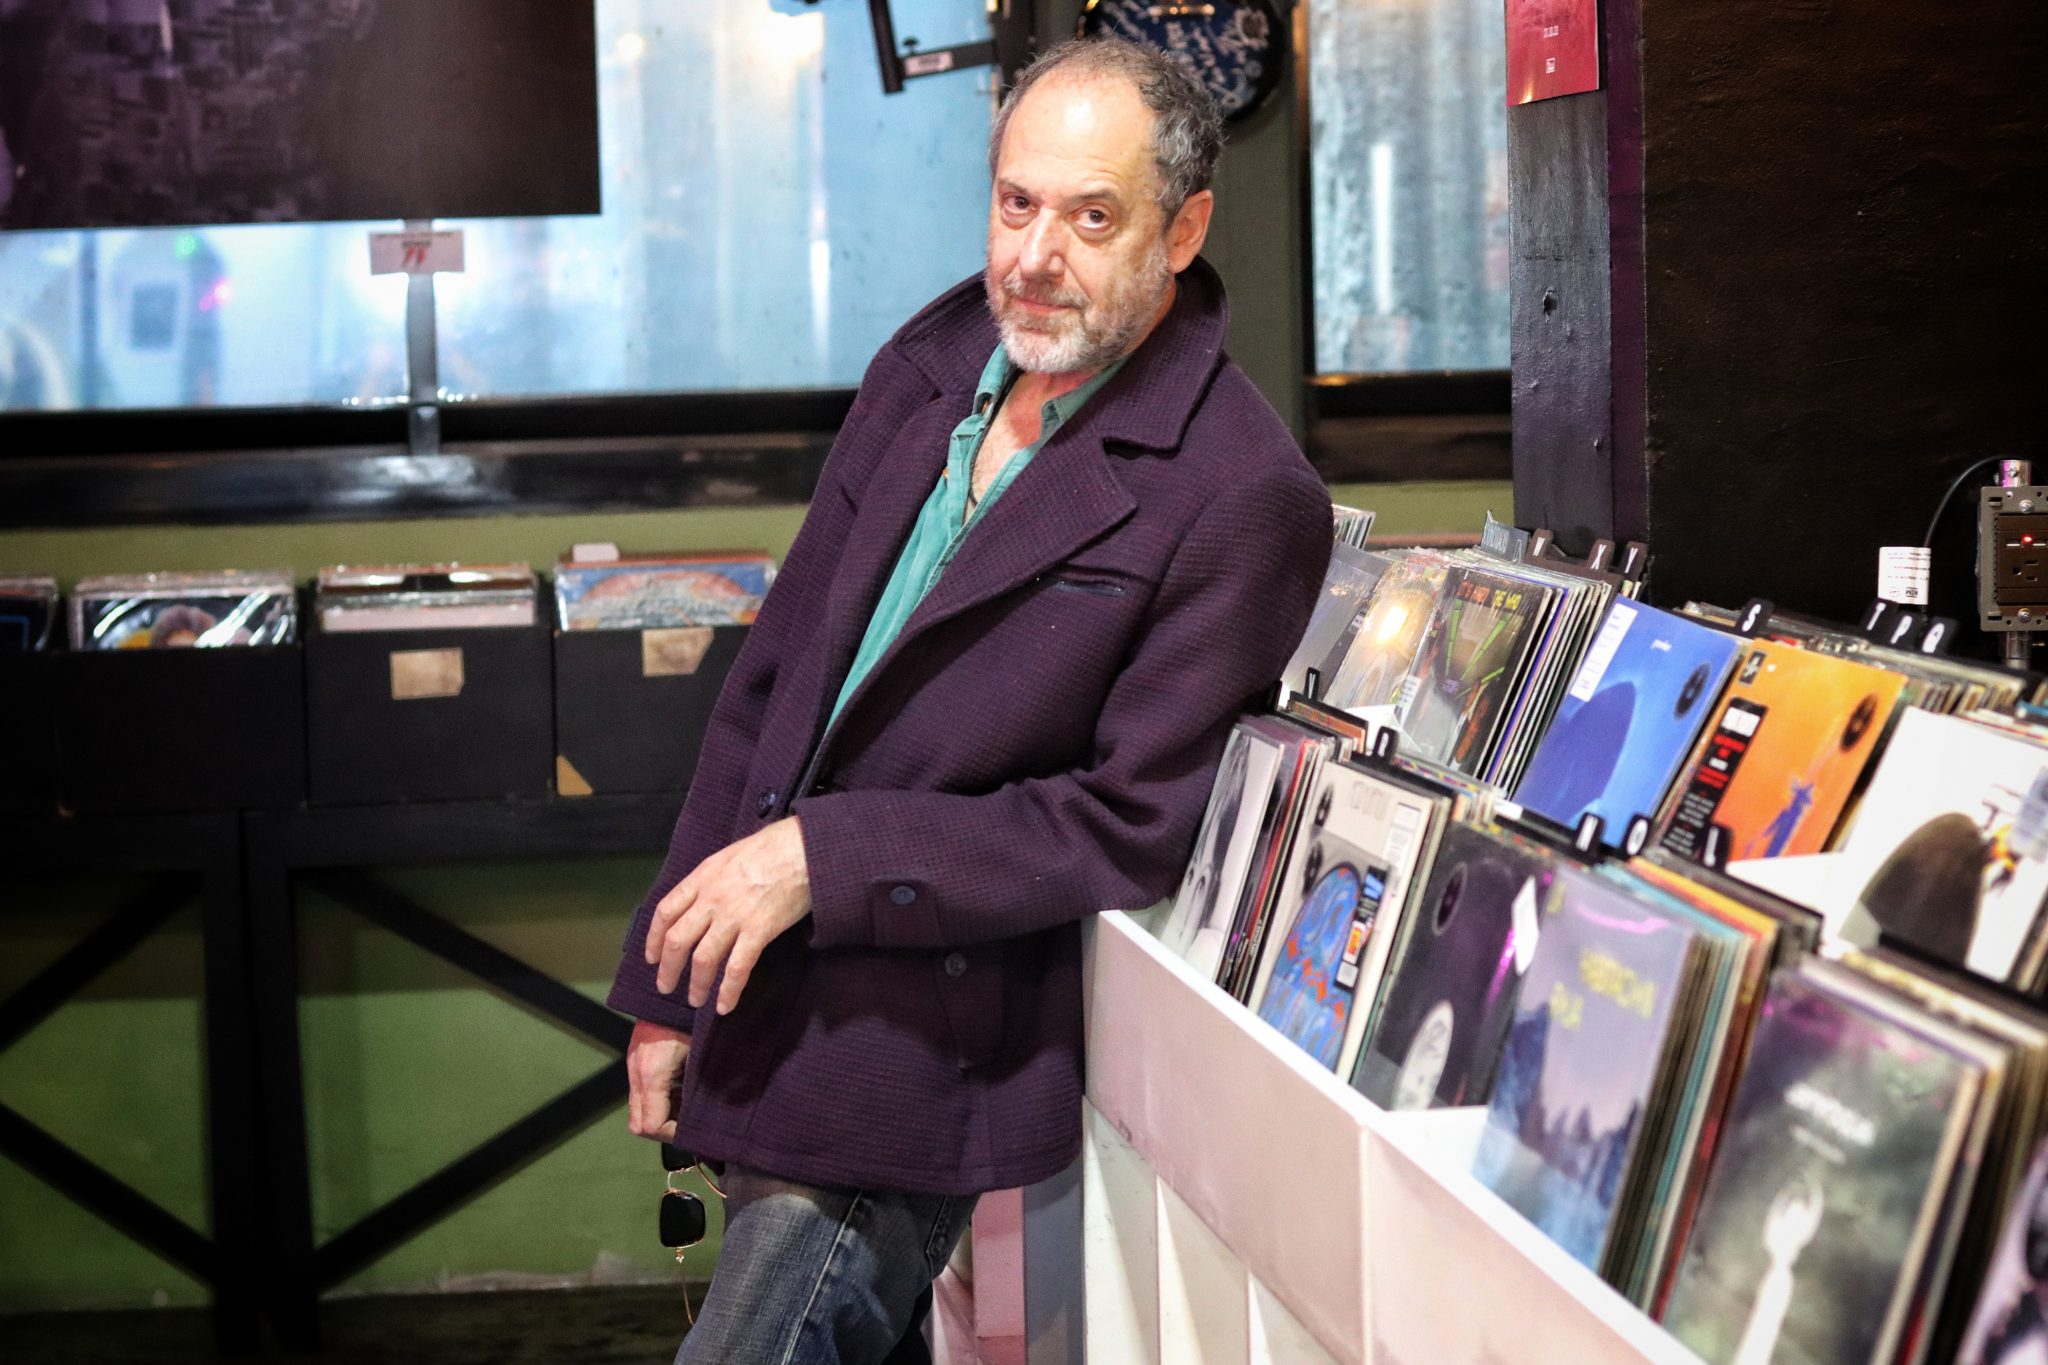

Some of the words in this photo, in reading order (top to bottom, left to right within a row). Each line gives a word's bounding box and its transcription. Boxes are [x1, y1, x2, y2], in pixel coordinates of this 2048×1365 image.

[1591, 544, 1607, 570] X
[1624, 547, 1639, 573] Y
[1741, 603, 1762, 632] S
[1866, 602, 1886, 631] T
[1890, 615, 1912, 644] P
[1626, 818, 1648, 855] O
